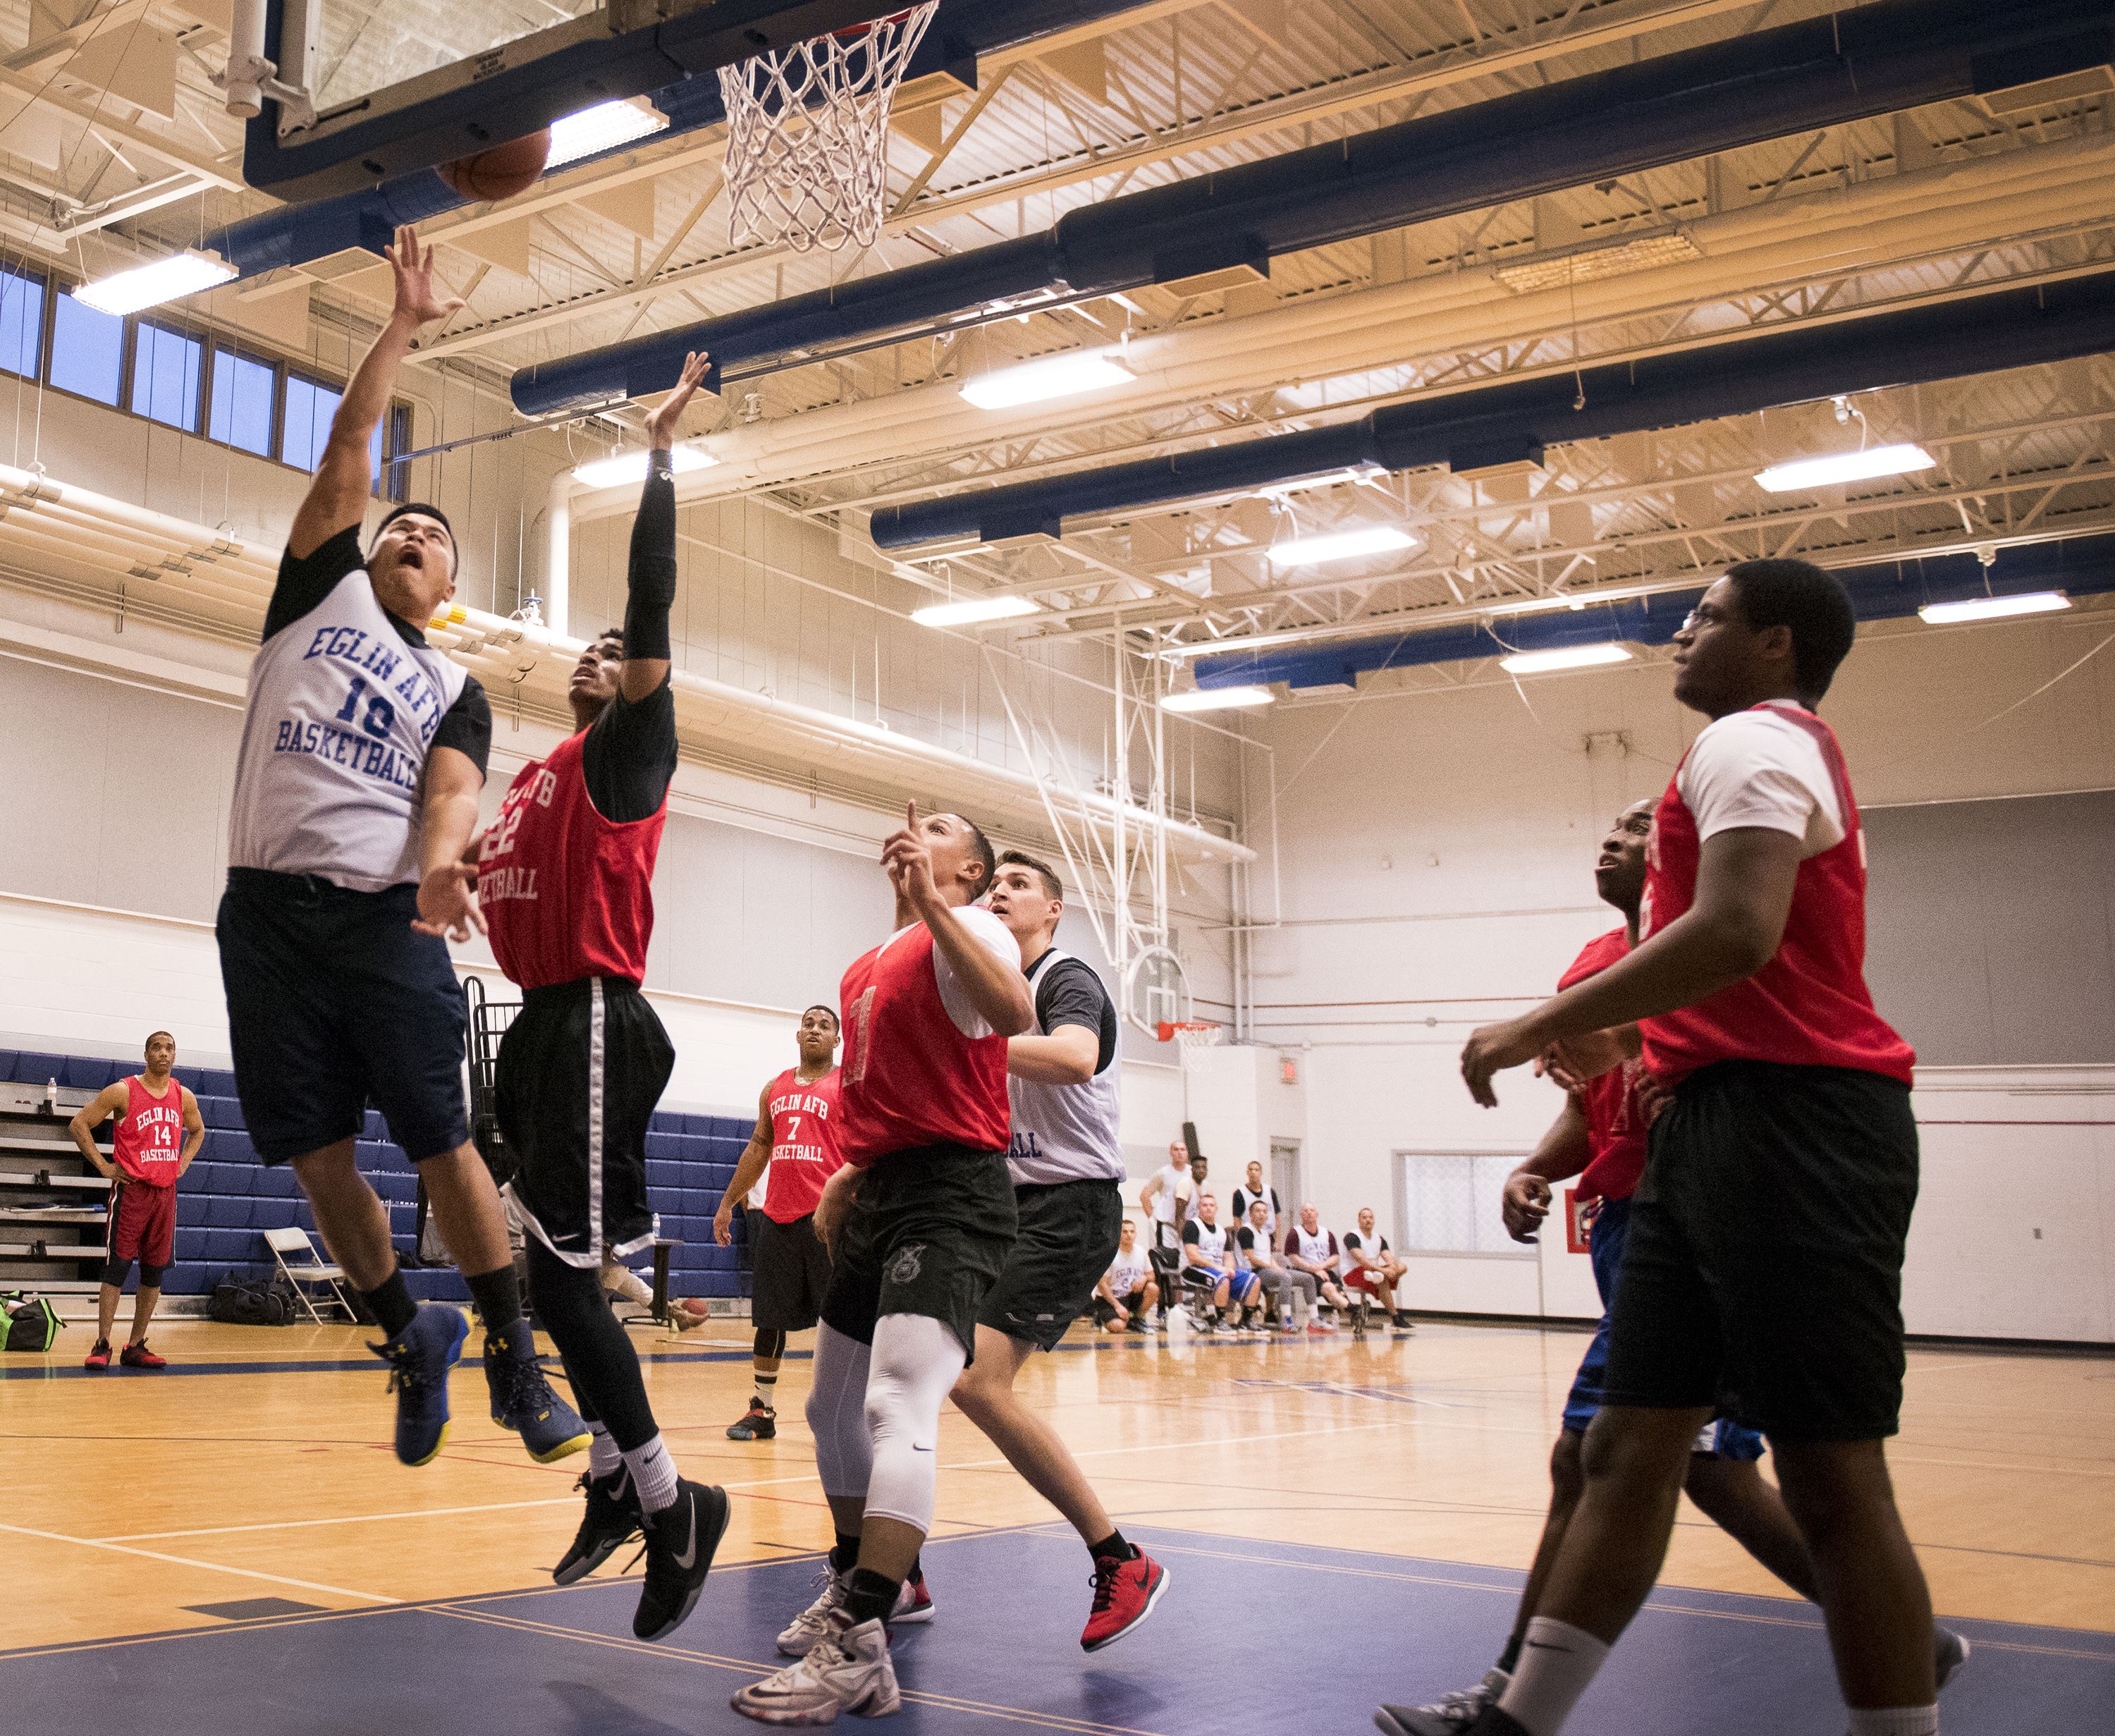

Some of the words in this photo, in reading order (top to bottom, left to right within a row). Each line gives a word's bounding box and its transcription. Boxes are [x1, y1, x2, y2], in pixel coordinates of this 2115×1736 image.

[303, 627, 403, 681] EGLIN
[394, 672, 441, 742] AFB
[274, 720, 417, 791] BASKETBALL
[136, 1106, 163, 1131] EGLIN
[164, 1107, 180, 1128] AFB
[770, 1094, 802, 1120] EGLIN
[802, 1094, 828, 1120] AFB
[154, 1125, 171, 1146] 14
[787, 1116, 802, 1140] 7
